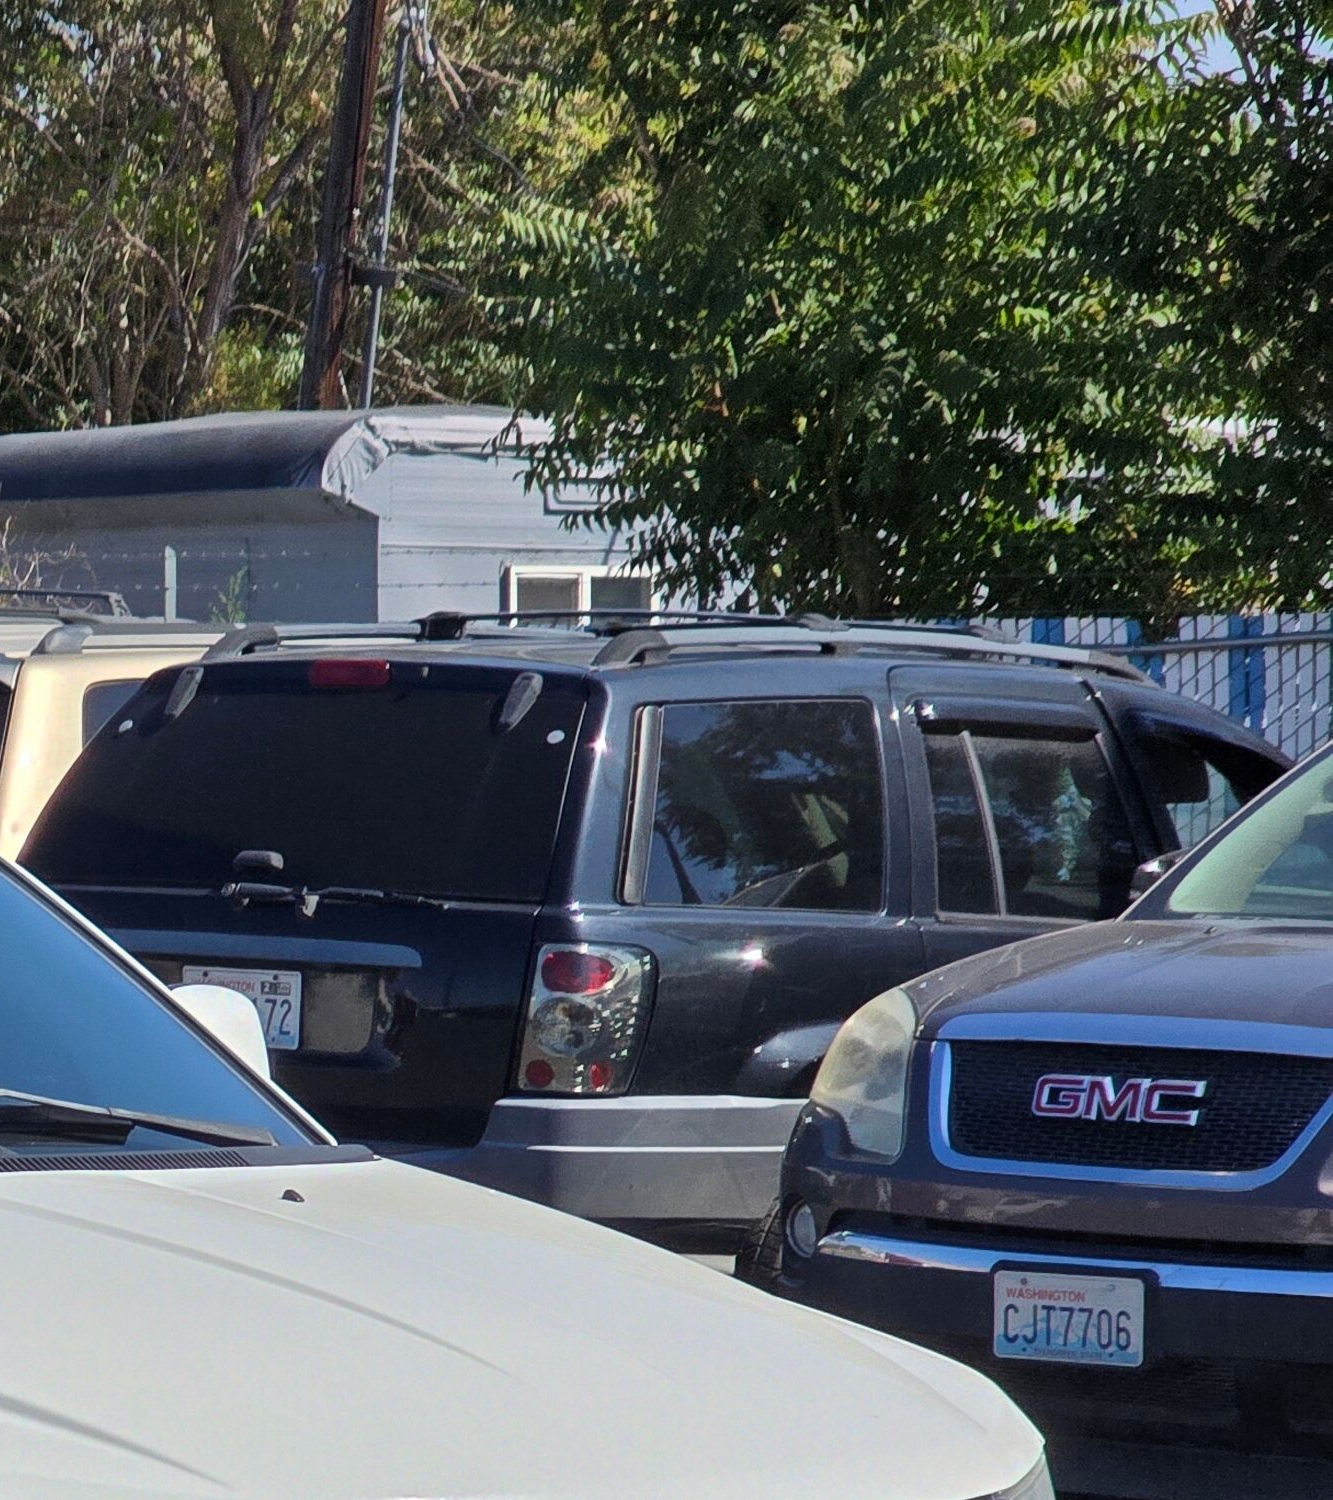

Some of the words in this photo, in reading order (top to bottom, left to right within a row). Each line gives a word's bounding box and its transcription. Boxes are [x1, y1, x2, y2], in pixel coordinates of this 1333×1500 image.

[1032, 1073, 1208, 1127] GMC
[1005, 1286, 1087, 1303] WASHINGTON
[1003, 1303, 1132, 1351] CJT7706
